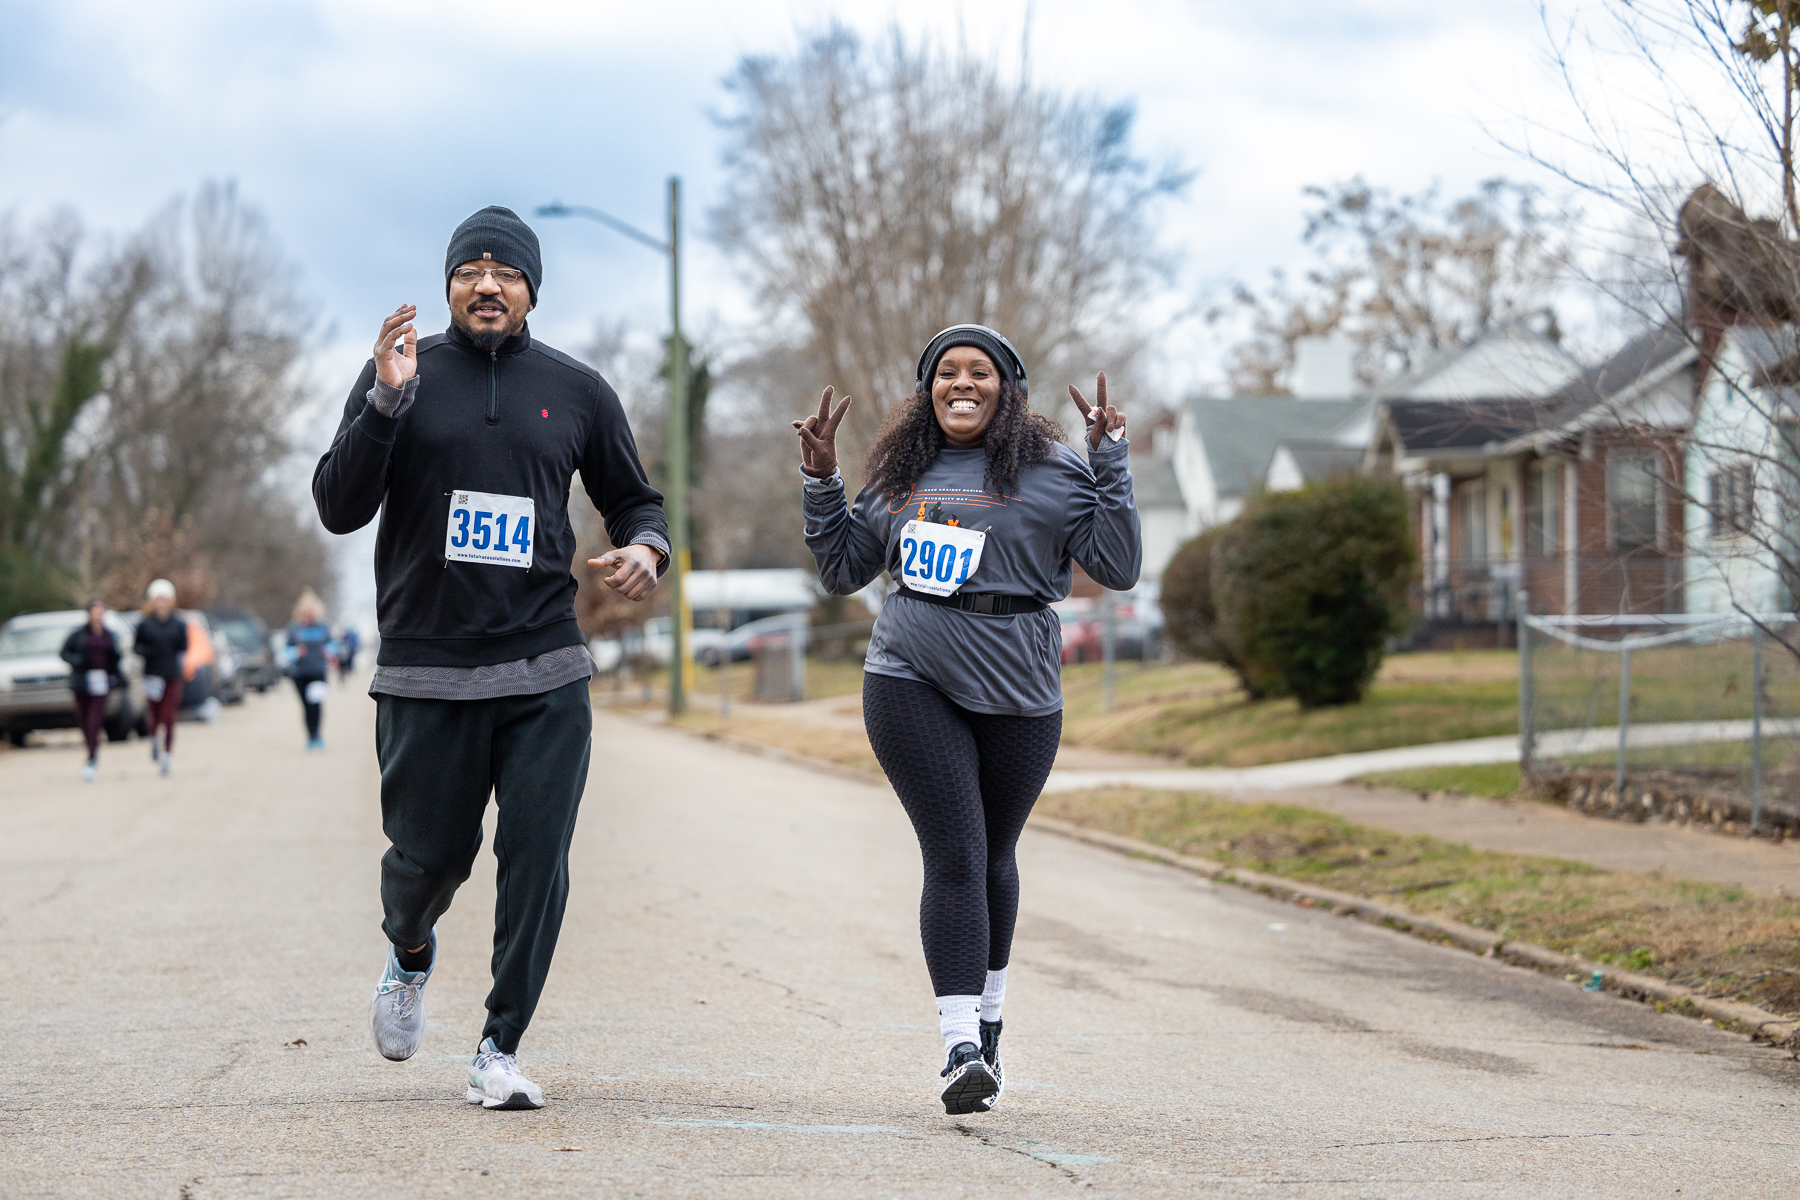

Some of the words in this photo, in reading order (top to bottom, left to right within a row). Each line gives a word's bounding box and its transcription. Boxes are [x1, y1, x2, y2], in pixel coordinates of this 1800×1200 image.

[451, 509, 530, 554] 3514
[457, 553, 521, 563] www.totalracesolutions.com
[903, 538, 973, 584] 2901
